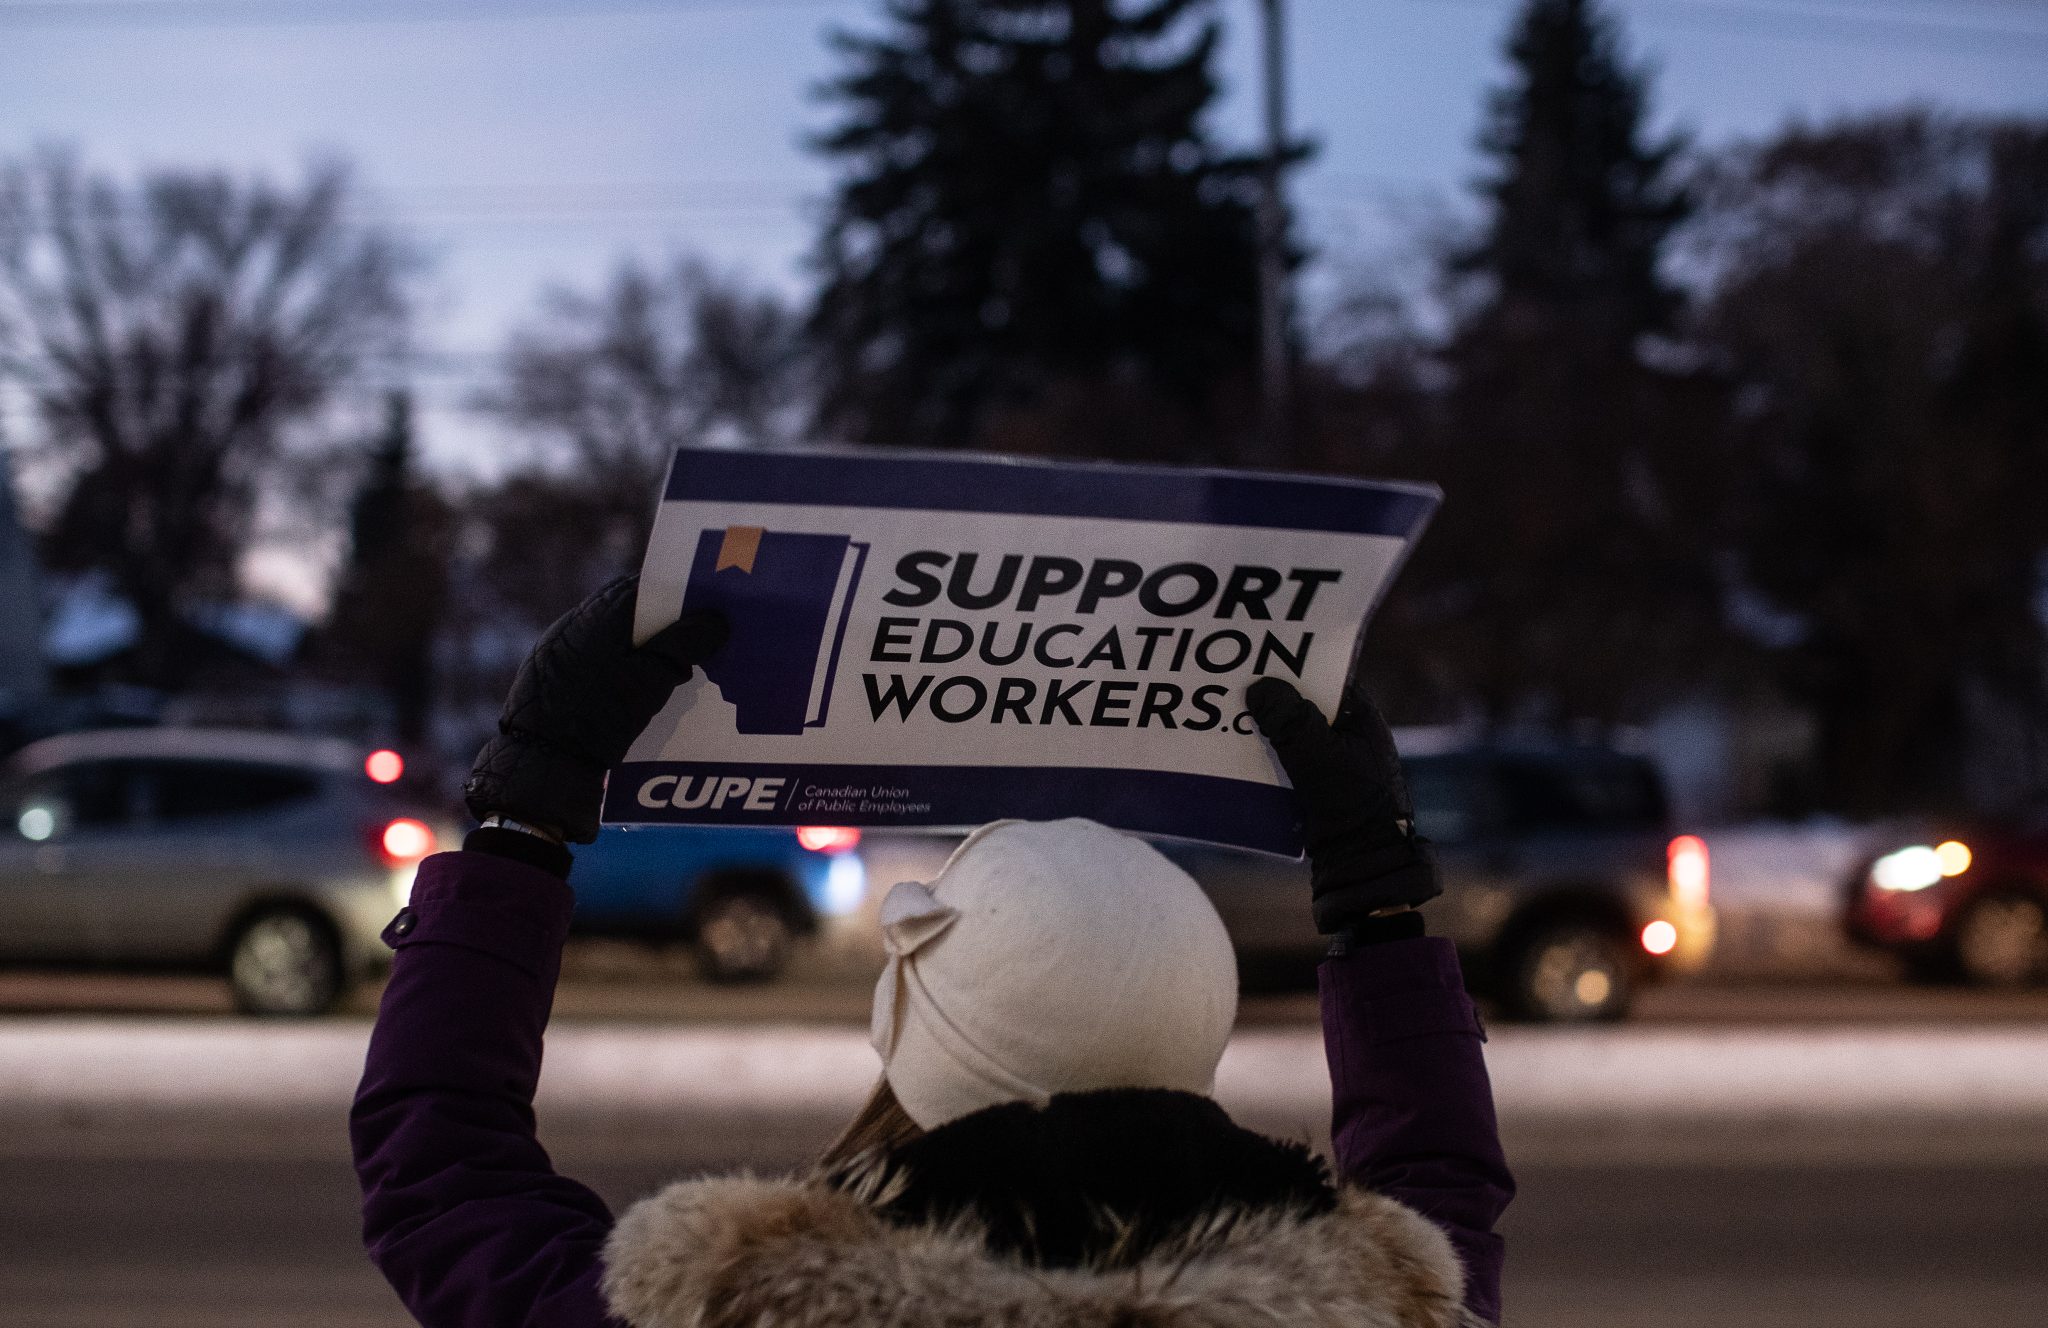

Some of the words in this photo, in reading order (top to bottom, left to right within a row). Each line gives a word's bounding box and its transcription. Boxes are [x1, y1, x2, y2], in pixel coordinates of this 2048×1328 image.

[882, 550, 1342, 622] SUPPORT
[869, 616, 1314, 679] EDUCATION
[637, 775, 786, 811] CUPE
[798, 798, 815, 813] of
[815, 799, 854, 814] Public
[858, 801, 931, 816] Employees
[804, 784, 867, 799] Canadian
[871, 786, 910, 799] Union
